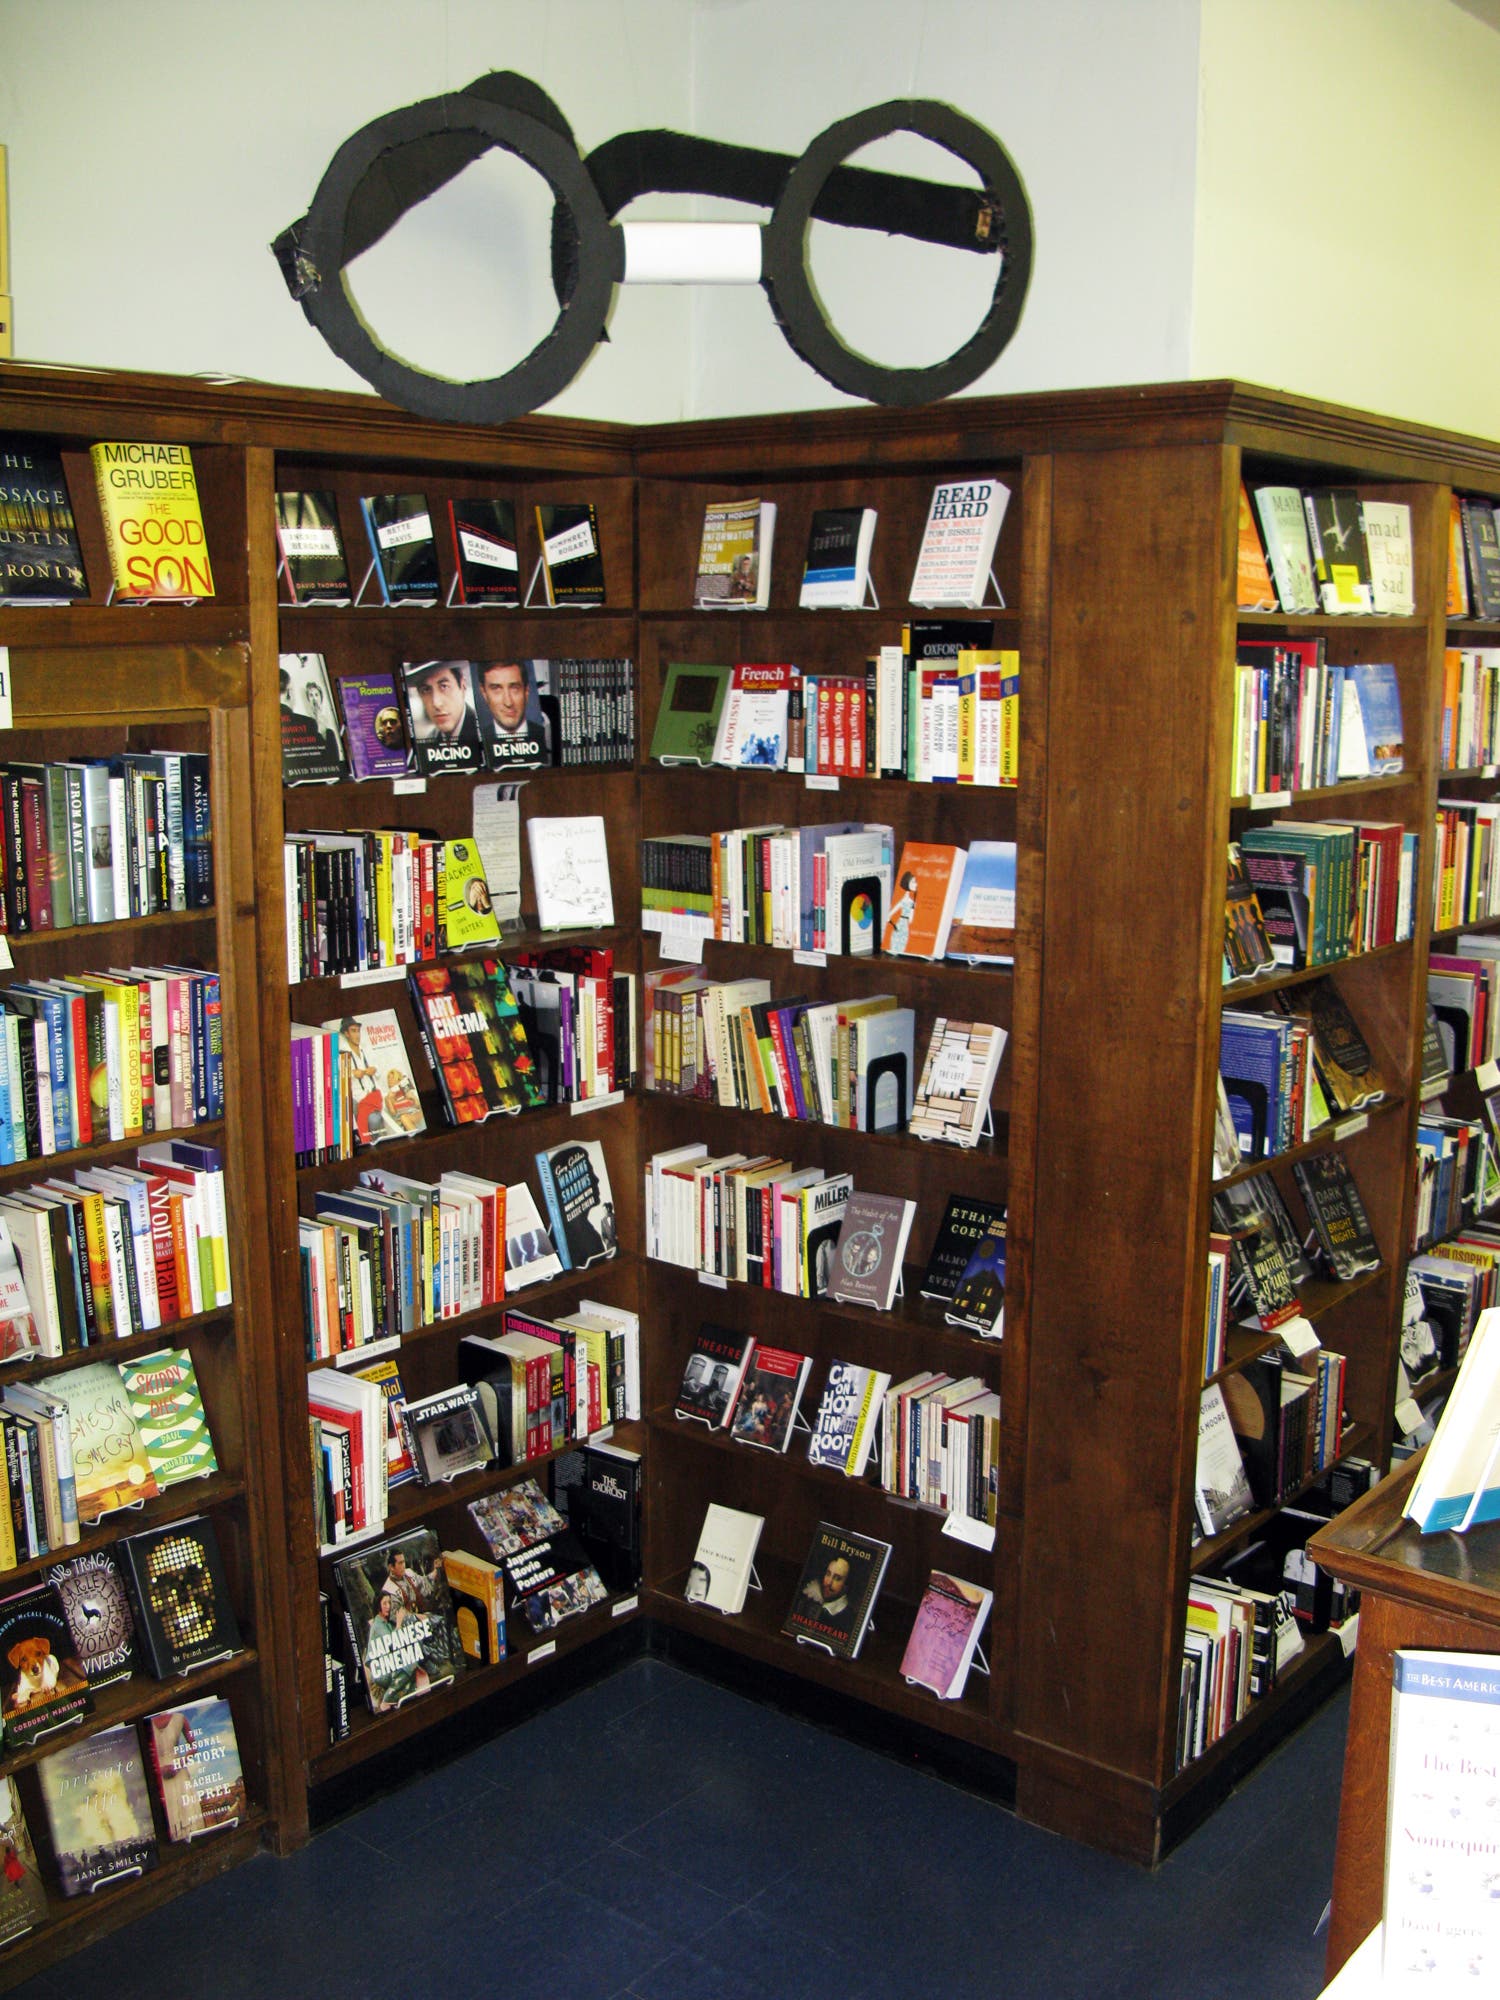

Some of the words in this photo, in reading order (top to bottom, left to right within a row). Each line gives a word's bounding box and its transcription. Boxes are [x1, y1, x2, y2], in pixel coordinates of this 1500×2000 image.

[105, 445, 191, 466] MICHAEL
[110, 469, 195, 490] GRUBER
[935, 485, 992, 505] READ
[148, 503, 171, 515] THE
[705, 513, 726, 522] JOHN
[931, 502, 989, 520] HARD
[120, 519, 203, 546] GOOD
[386, 522, 411, 535] BETTE
[703, 530, 755, 542] INFORMATION
[1368, 515, 1401, 538] mad
[1481, 524, 1495, 542] 13
[389, 533, 412, 545] DAVIS
[558, 539, 589, 555] BOGART
[702, 543, 723, 552] THAN
[468, 548, 498, 562] COOPER
[701, 553, 717, 563] YOU
[1386, 541, 1410, 567] bad
[127, 556, 211, 595] SON
[699, 562, 733, 574] REQUIRE
[296, 582, 315, 590] DAVID
[388, 583, 408, 591] DAVID
[410, 582, 439, 590] THOMSON
[1382, 571, 1404, 594] sad
[923, 643, 964, 656] OXFORD
[741, 667, 785, 681] French
[360, 686, 393, 696] Romero
[723, 695, 742, 762] LAROUSSE
[427, 746, 472, 762] PACINO
[961, 738, 969, 763] VERBS
[170, 763, 180, 777] ALL
[69, 782, 82, 819] FROM
[170, 781, 181, 801] THAT
[156, 782, 167, 831] Generation
[193, 775, 204, 832] PASSAGE
[171, 805, 183, 844] FOLLOWS
[72, 822, 84, 854] AWAY
[158, 832, 169, 851] A
[425, 847, 434, 868] KEVIN
[426, 869, 434, 892] SMITH
[437, 871, 447, 897] KEVIN
[414, 881, 422, 928] CONFIDENTIAL
[438, 899, 447, 925] SMITH
[397, 908, 405, 949] polanski
[460, 919, 484, 935] WATERS
[125, 989, 133, 1021] GRUBER
[179, 981, 191, 1034] ANTHROPOLOGY
[427, 995, 457, 1018] ART
[52, 1003, 63, 1044] WILLIAM
[128, 1022, 138, 1048] THE
[366, 1024, 395, 1035] Making
[432, 1011, 489, 1039] CINEMA
[94, 1015, 102, 1062] COLLECTOR
[143, 1020, 152, 1060] HOUSE
[209, 1017, 218, 1055] HARRIS
[369, 1033, 397, 1046] Waves
[55, 1048, 65, 1082] GIBSON
[128, 1049, 139, 1087] GOOD
[422, 1043, 436, 1070] CINEMA
[182, 1052, 192, 1089] AMERICAN
[22, 1046, 38, 1131] RECKLESS
[211, 1072, 219, 1096] FAMILY
[54, 1090, 64, 1128] history
[130, 1089, 140, 1115] SON
[184, 1091, 192, 1110] GIRL
[557, 1159, 589, 1188] WARNING
[561, 1173, 591, 1203] SHADOWS
[814, 1186, 850, 1212] MILLER
[1315, 1188, 1342, 1203] DARK
[93, 1198, 103, 1226] DEXTER
[150, 1183, 173, 1240] Wolf
[566, 1208, 582, 1222] CLASSIC
[581, 1198, 595, 1213] CINEMA
[851, 1206, 862, 1215] The
[862, 1206, 878, 1217] Habit
[887, 1211, 898, 1220] Art
[1322, 1202, 1348, 1221] DAYS
[77, 1225, 87, 1249] LONG
[1327, 1217, 1352, 1233] BRIGHT
[1330, 1228, 1357, 1245] NIGHTS
[97, 1236, 108, 1271] DELICIOUS
[112, 1229, 123, 1254] Ask
[79, 1251, 90, 1274] SONG
[1431, 1247, 1489, 1267] PHILOSOPHY
[5, 1282, 20, 1293] THE
[155, 1259, 176, 1300] Hall
[853, 1278, 877, 1291] Bennett
[507, 1317, 536, 1336] CINEMA
[535, 1326, 561, 1344] SEWER
[697, 1337, 742, 1360] THEATRE
[136, 1365, 182, 1394] SKIPPY
[835, 1384, 851, 1395] ON
[150, 1393, 180, 1418] DIES
[416, 1403, 449, 1421] STAR
[448, 1390, 478, 1409] WARS
[618, 1385, 626, 1419] Classic
[823, 1389, 856, 1414] HOT
[848, 1427, 865, 1471] Tennessee
[861, 1374, 877, 1418] Williams
[1205, 1413, 1226, 1432] MOORE
[104, 1433, 135, 1462] CRY
[160, 1431, 182, 1444] PAUL
[809, 1432, 853, 1459] ROOF
[161, 1455, 196, 1474] MURRAY
[341, 1435, 352, 1511] EYEBALL
[592, 1482, 627, 1500] EXORCIST
[602, 1475, 617, 1487] THE
[505, 1542, 552, 1569] Japanese
[821, 1534, 838, 1548] Bill
[839, 1541, 872, 1561] Bryson
[48, 1566, 71, 1588] OUR
[71, 1552, 116, 1574] TRAGIC
[510, 1560, 541, 1580] Movie
[516, 1567, 556, 1591] Posters
[44, 1613, 65, 1628] SMITH
[791, 1612, 849, 1642] SHAKESPEARE
[343, 1610, 356, 1640] JAPANESE
[352, 1640, 362, 1667] CINEMA
[368, 1616, 434, 1659] JAPANESE
[369, 1641, 425, 1679] CINEMA
[338, 1672, 347, 1700] STAR
[1406, 1672, 1419, 1682] THE
[1421, 1673, 1453, 1688] BEST
[14, 1713, 49, 1733] CORDUROY
[52, 1697, 87, 1716] MANSIONS
[340, 1699, 349, 1726] WARS
[173, 1734, 222, 1754] PERSONAL
[189, 1729, 202, 1738] THE
[173, 1746, 227, 1770] HISTORY
[1424, 1754, 1451, 1773] The
[1461, 1758, 1497, 1778] Best
[60, 1758, 135, 1796] private
[184, 1772, 224, 1790] RACHEL
[85, 1791, 118, 1812] life
[74, 1865, 104, 1882] JANE
[108, 1851, 150, 1871] SMILEY
